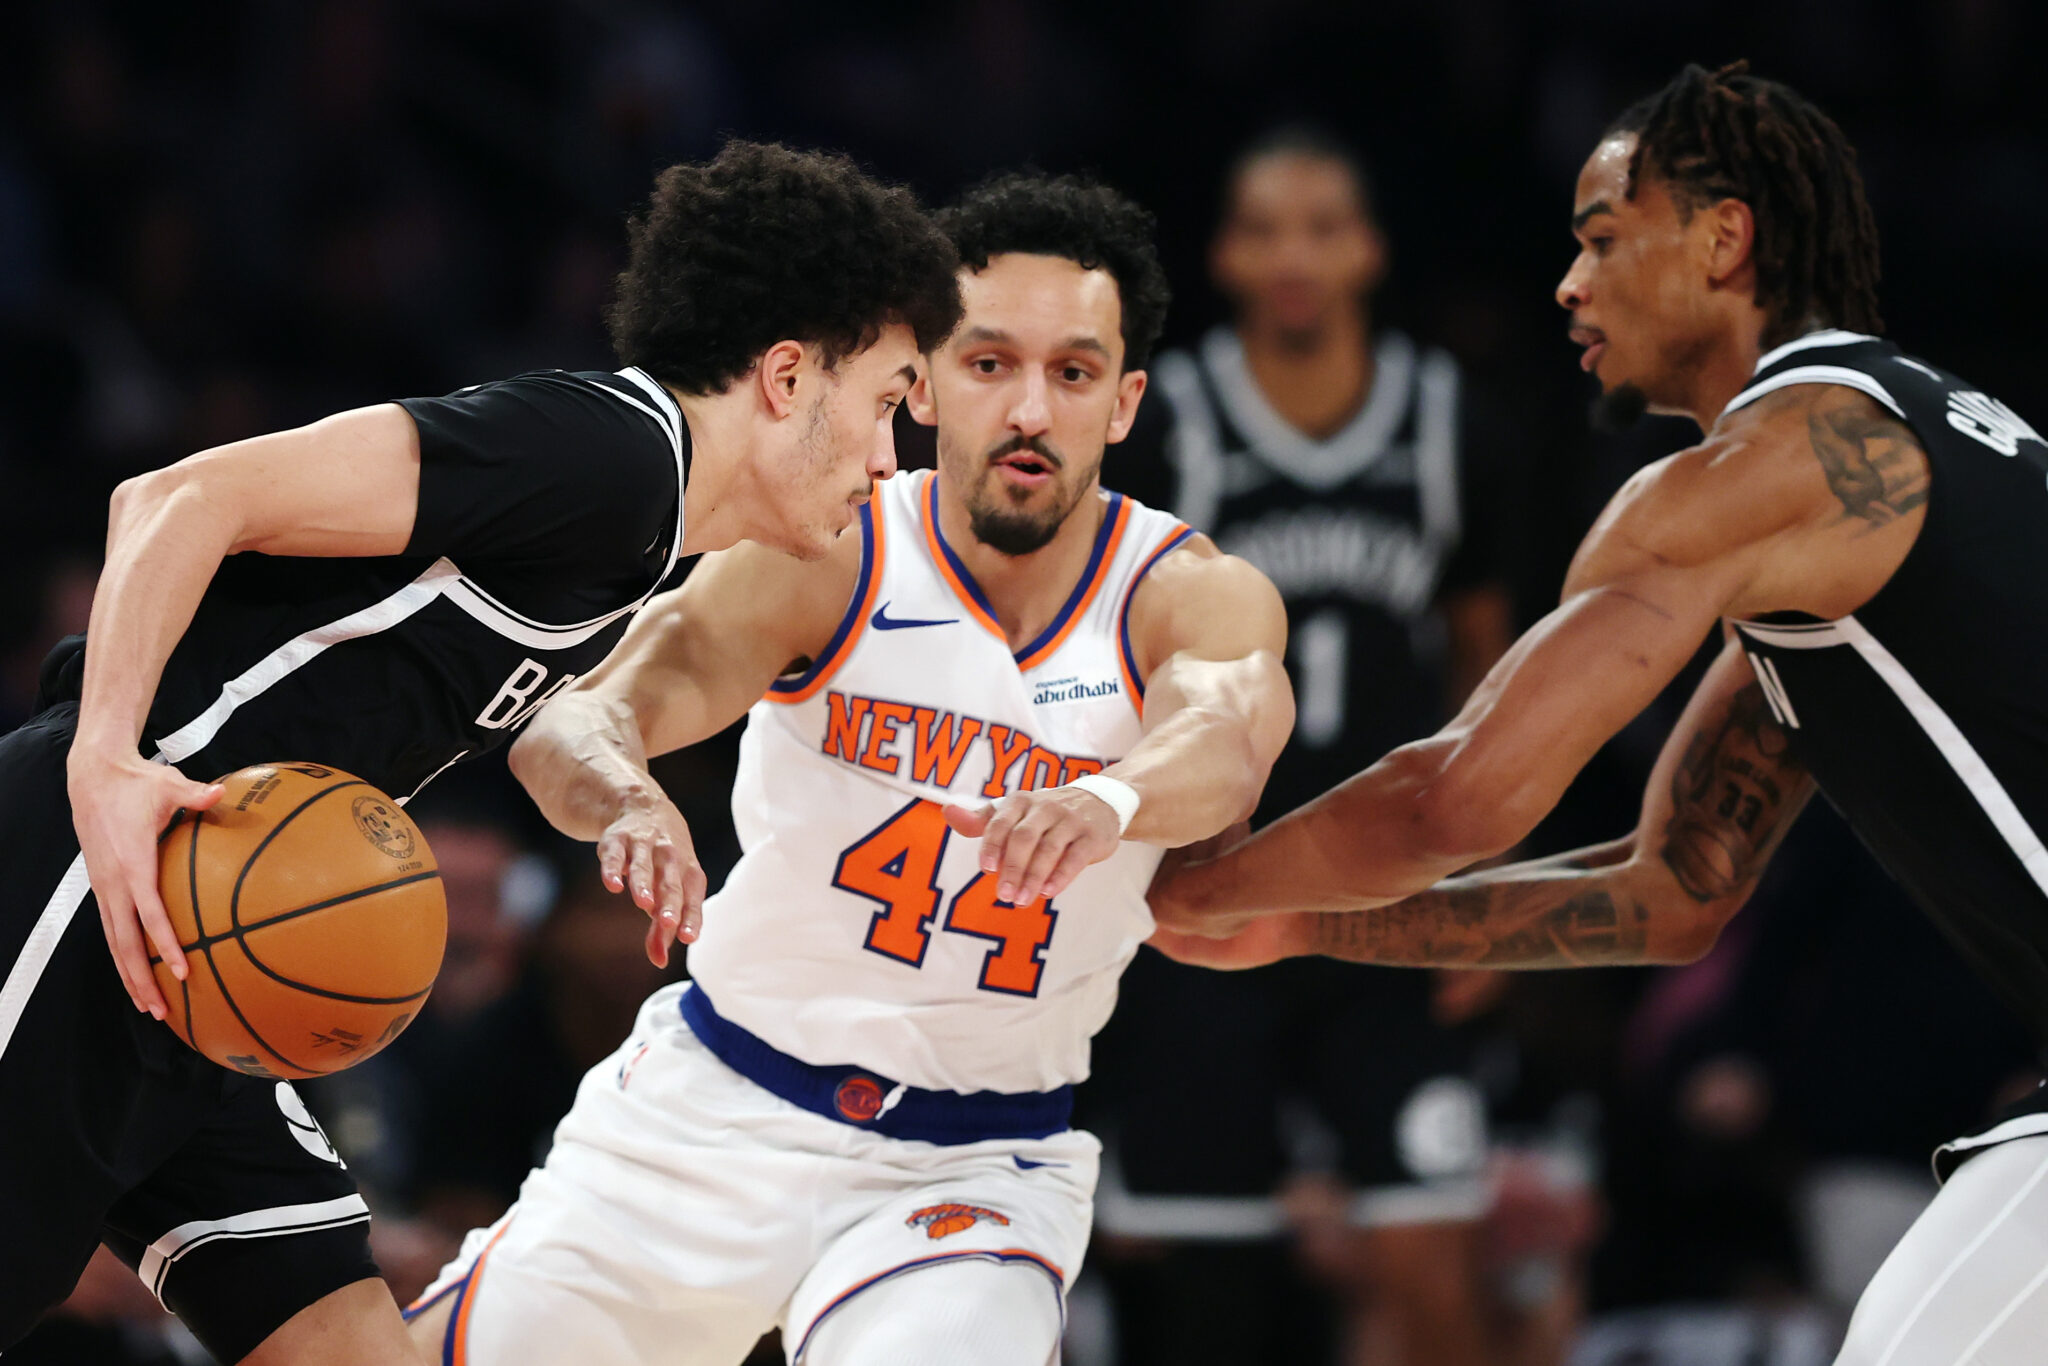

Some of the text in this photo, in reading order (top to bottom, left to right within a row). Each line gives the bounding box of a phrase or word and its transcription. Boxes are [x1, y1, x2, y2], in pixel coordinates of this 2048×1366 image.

[821, 690, 981, 789] NEW
[1033, 678, 1119, 705] abu dhabi
[831, 796, 1059, 999] 44
